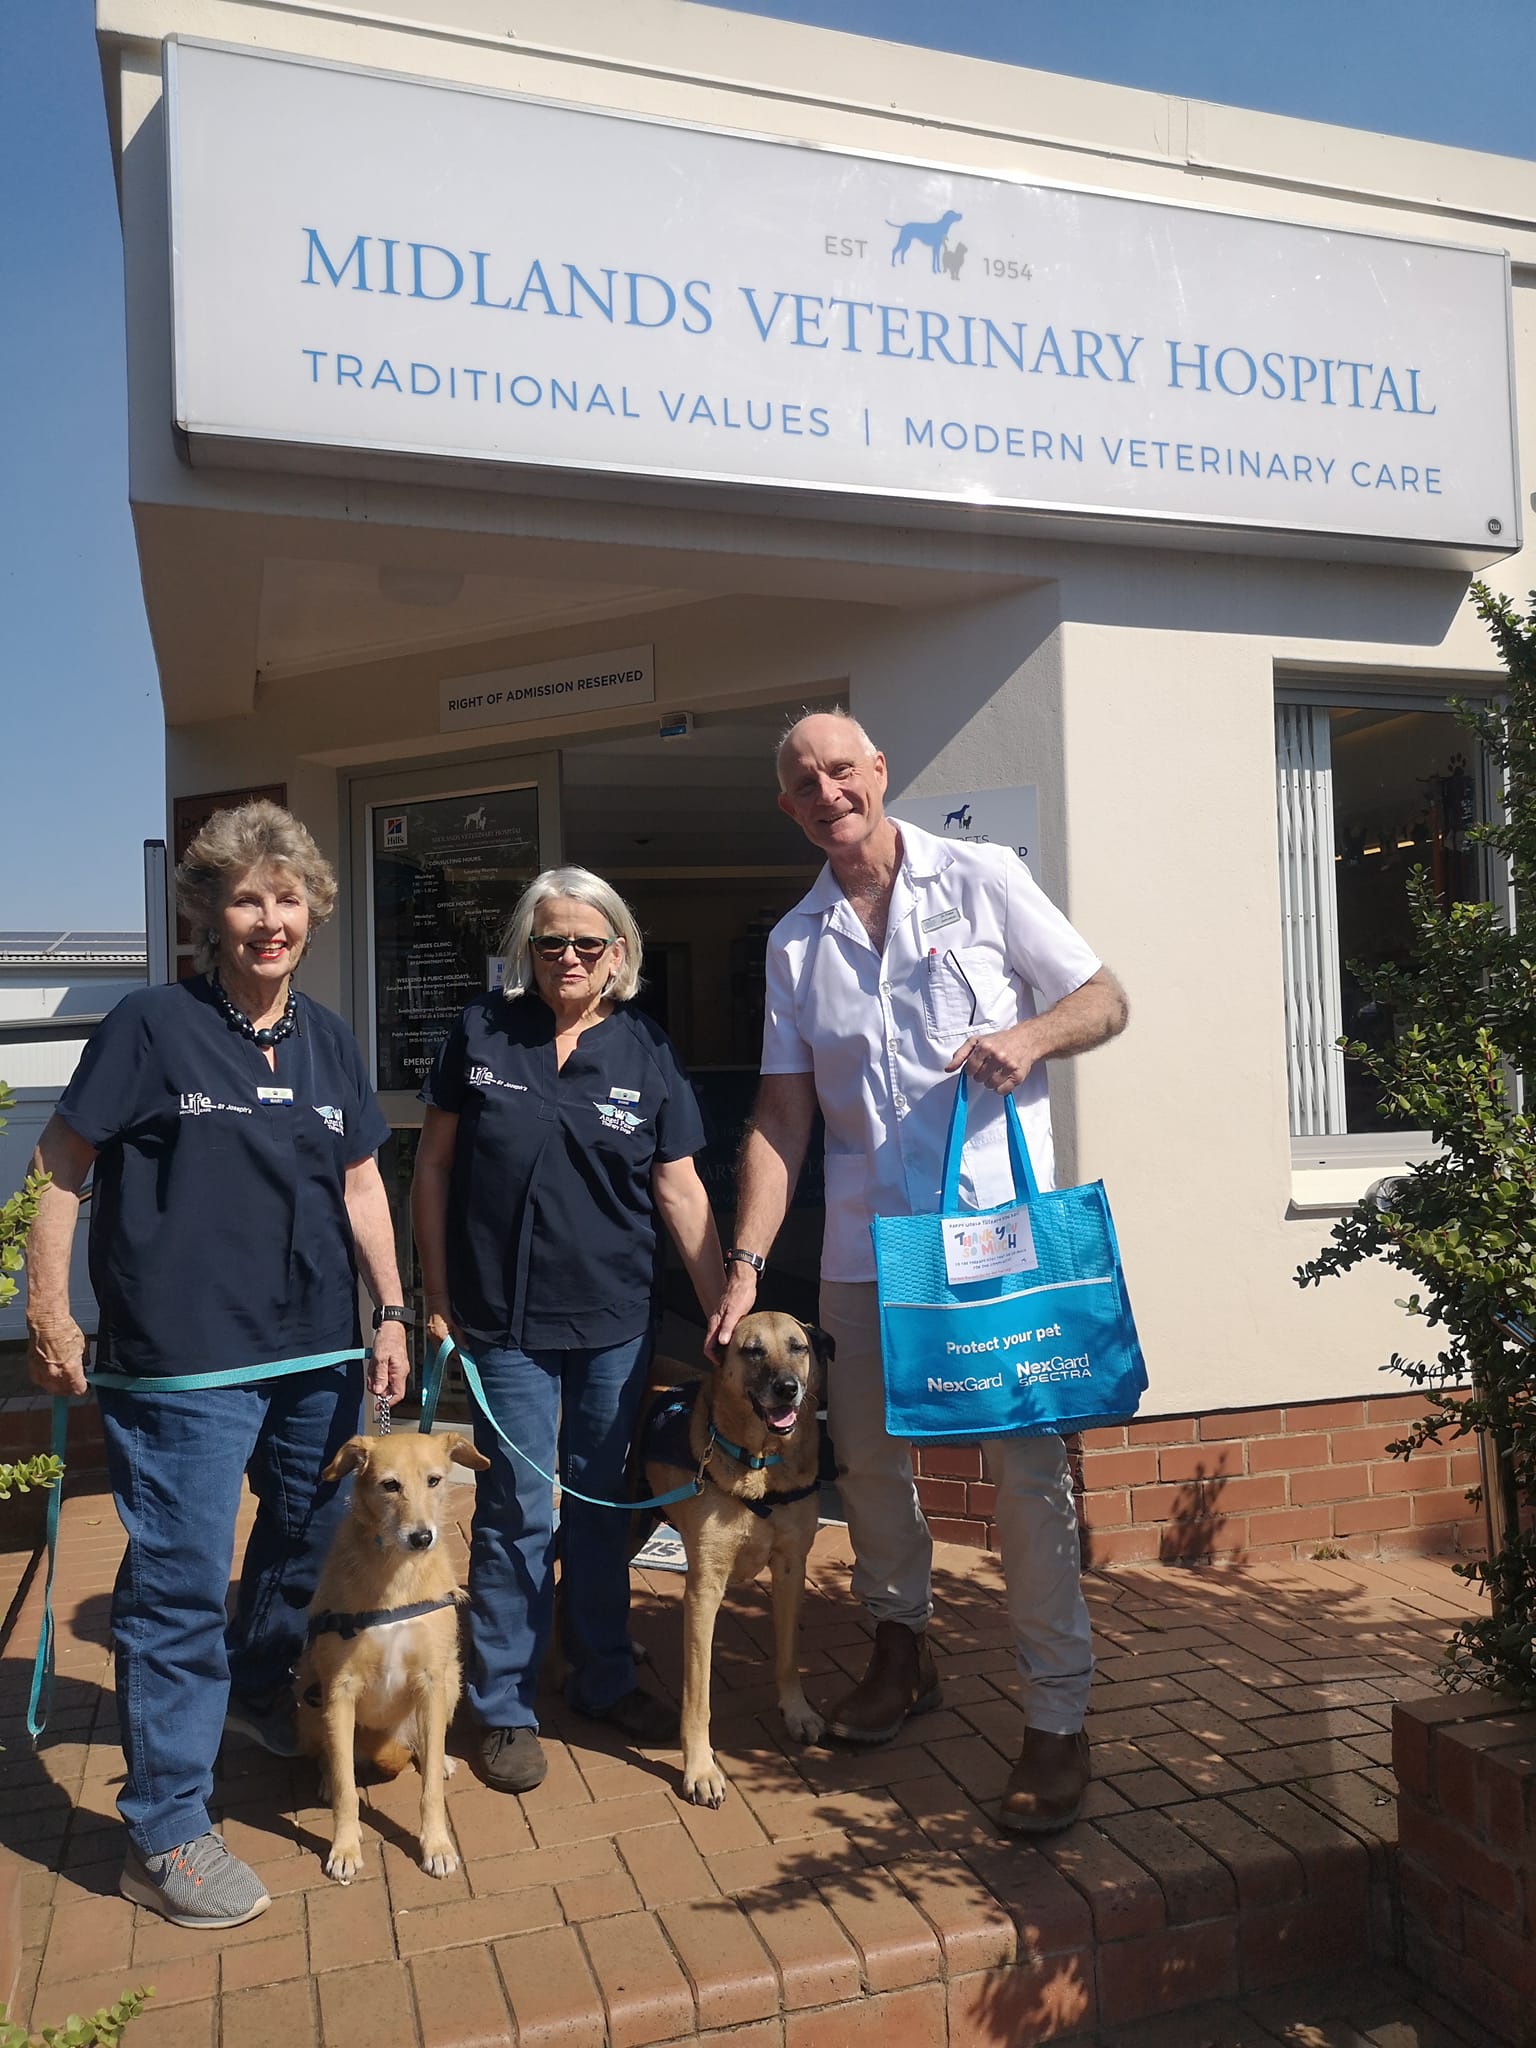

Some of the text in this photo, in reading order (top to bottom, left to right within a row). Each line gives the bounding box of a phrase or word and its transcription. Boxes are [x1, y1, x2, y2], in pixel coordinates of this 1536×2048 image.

[825, 235, 1034, 282] EST 1954
[302, 227, 1437, 416] MIDLANDS VETERINARY HOSPITAL
[302, 349, 1442, 495] TRADITIONAL VALUES MODERN VETERINARY CARE
[448, 670, 644, 711] RIGHT OF ADMISSION RESERVED
[470, 1066, 494, 1086] Life
[180, 1092, 213, 1115] Life
[954, 1228, 994, 1248] THANK
[962, 1246, 978, 1259] SO
[981, 1233, 1017, 1257] MUCH
[945, 1323, 1062, 1355] Protect your pet
[1015, 1353, 1090, 1379] NexGard
[1018, 1367, 1092, 1387] SPECTRA
[926, 1372, 1003, 1394] NexGard
